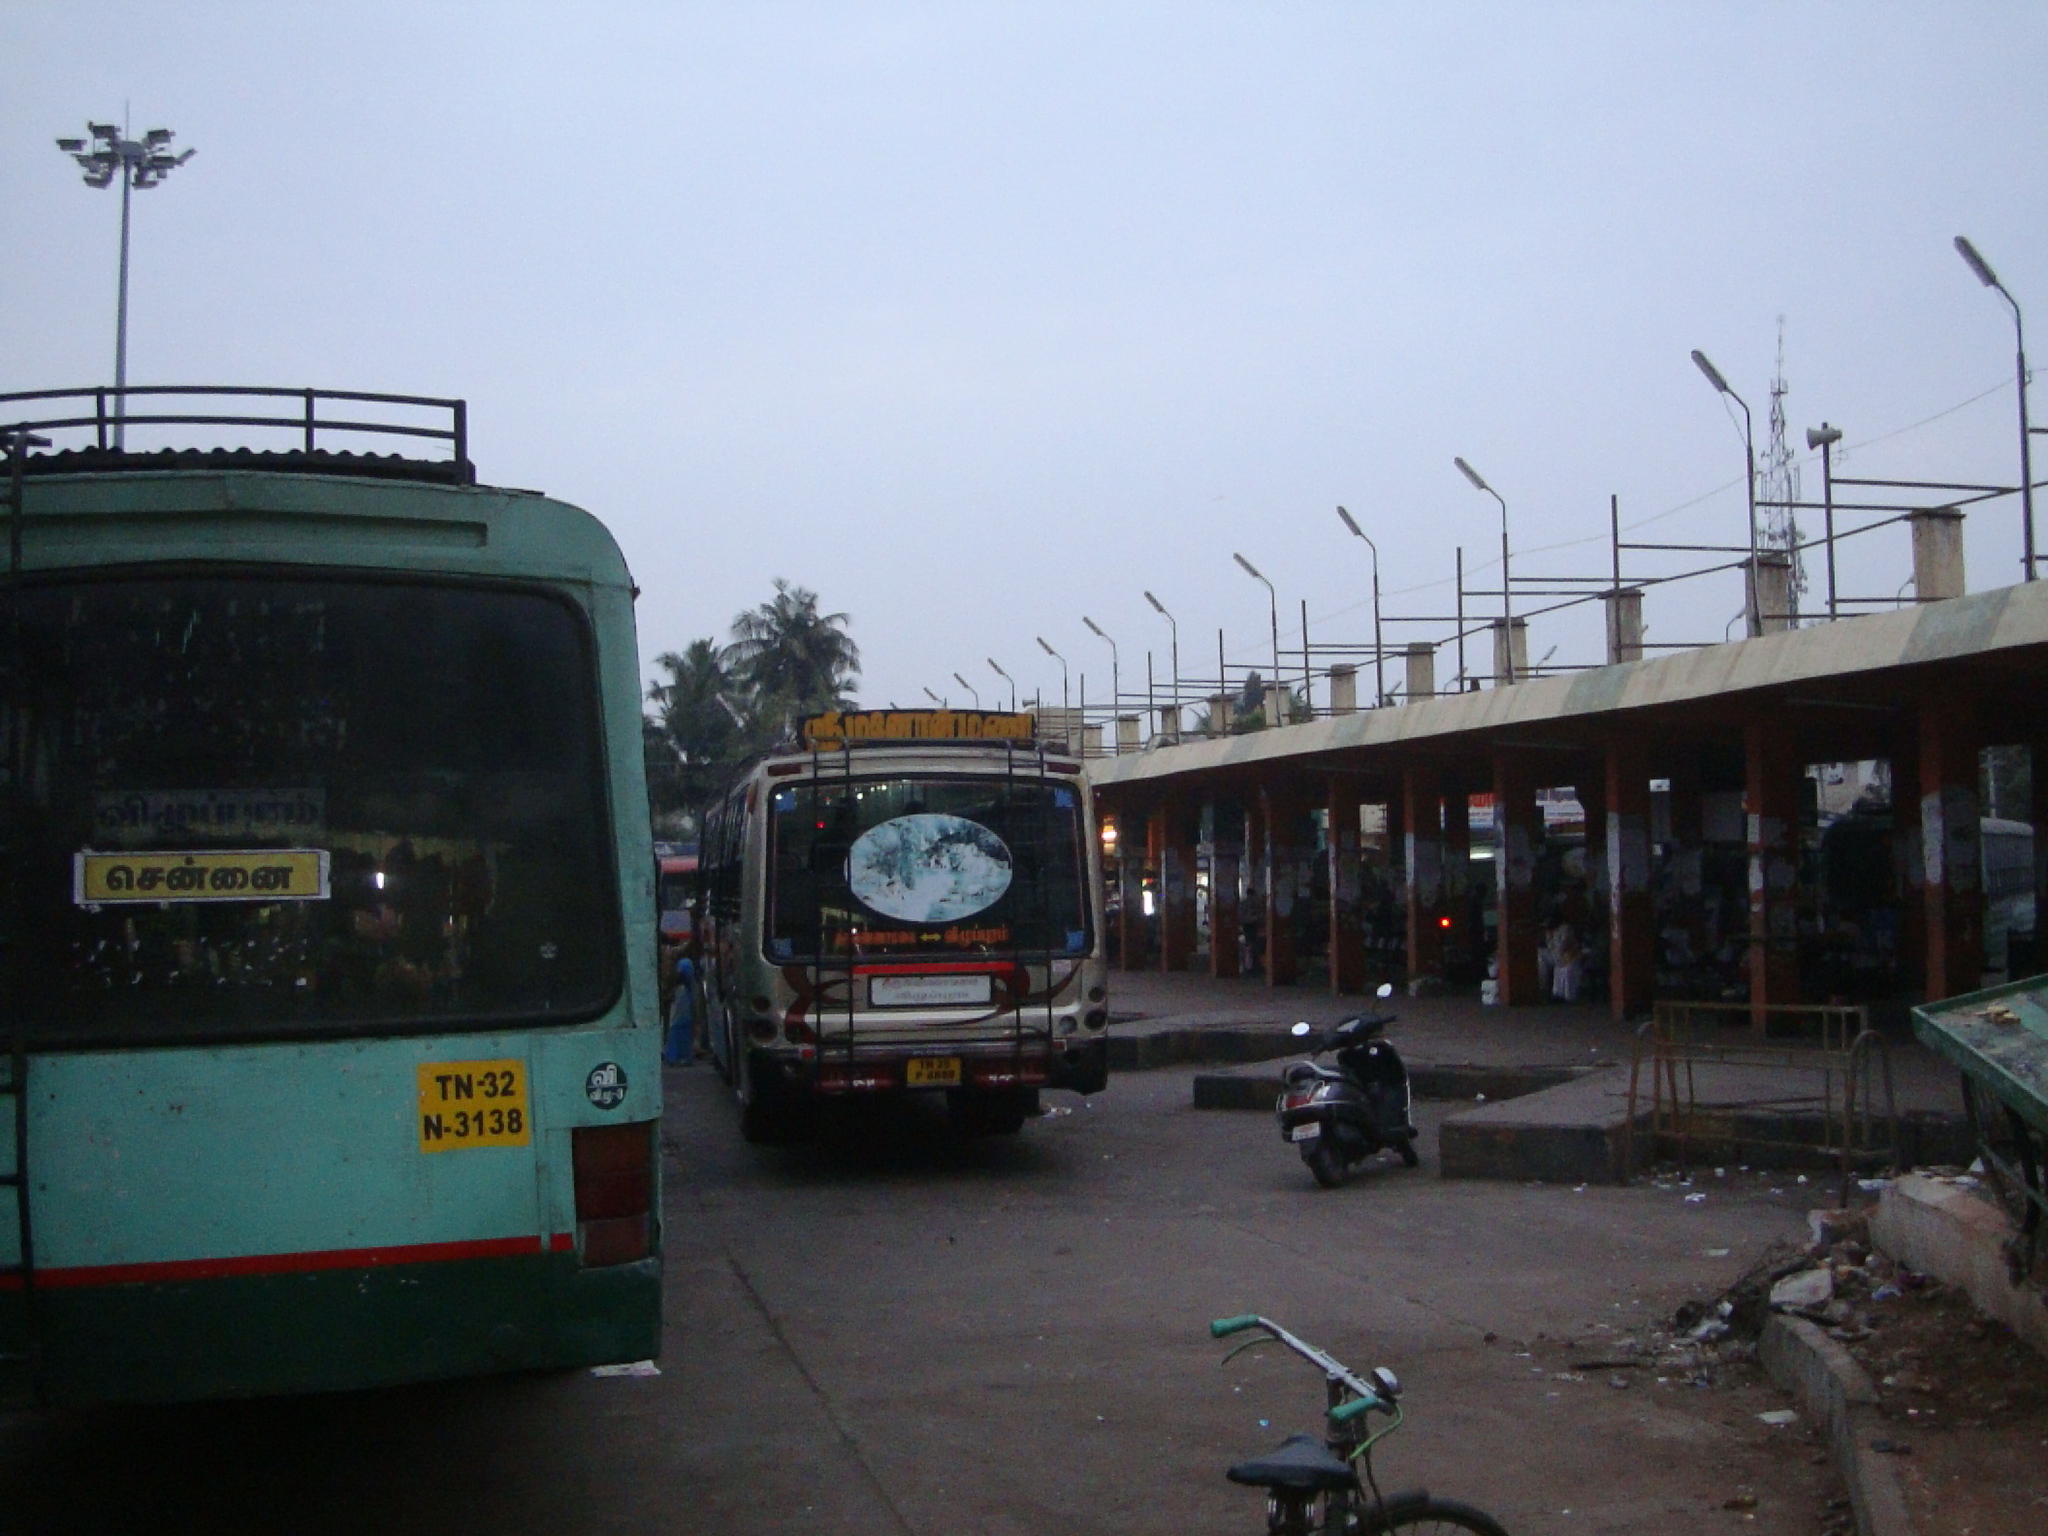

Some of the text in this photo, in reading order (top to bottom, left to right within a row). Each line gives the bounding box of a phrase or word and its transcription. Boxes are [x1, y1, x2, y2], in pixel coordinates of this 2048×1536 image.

[106, 856, 293, 891] சென்னை
[435, 1070, 516, 1101] TN-32
[424, 1108, 522, 1141] N-3138
